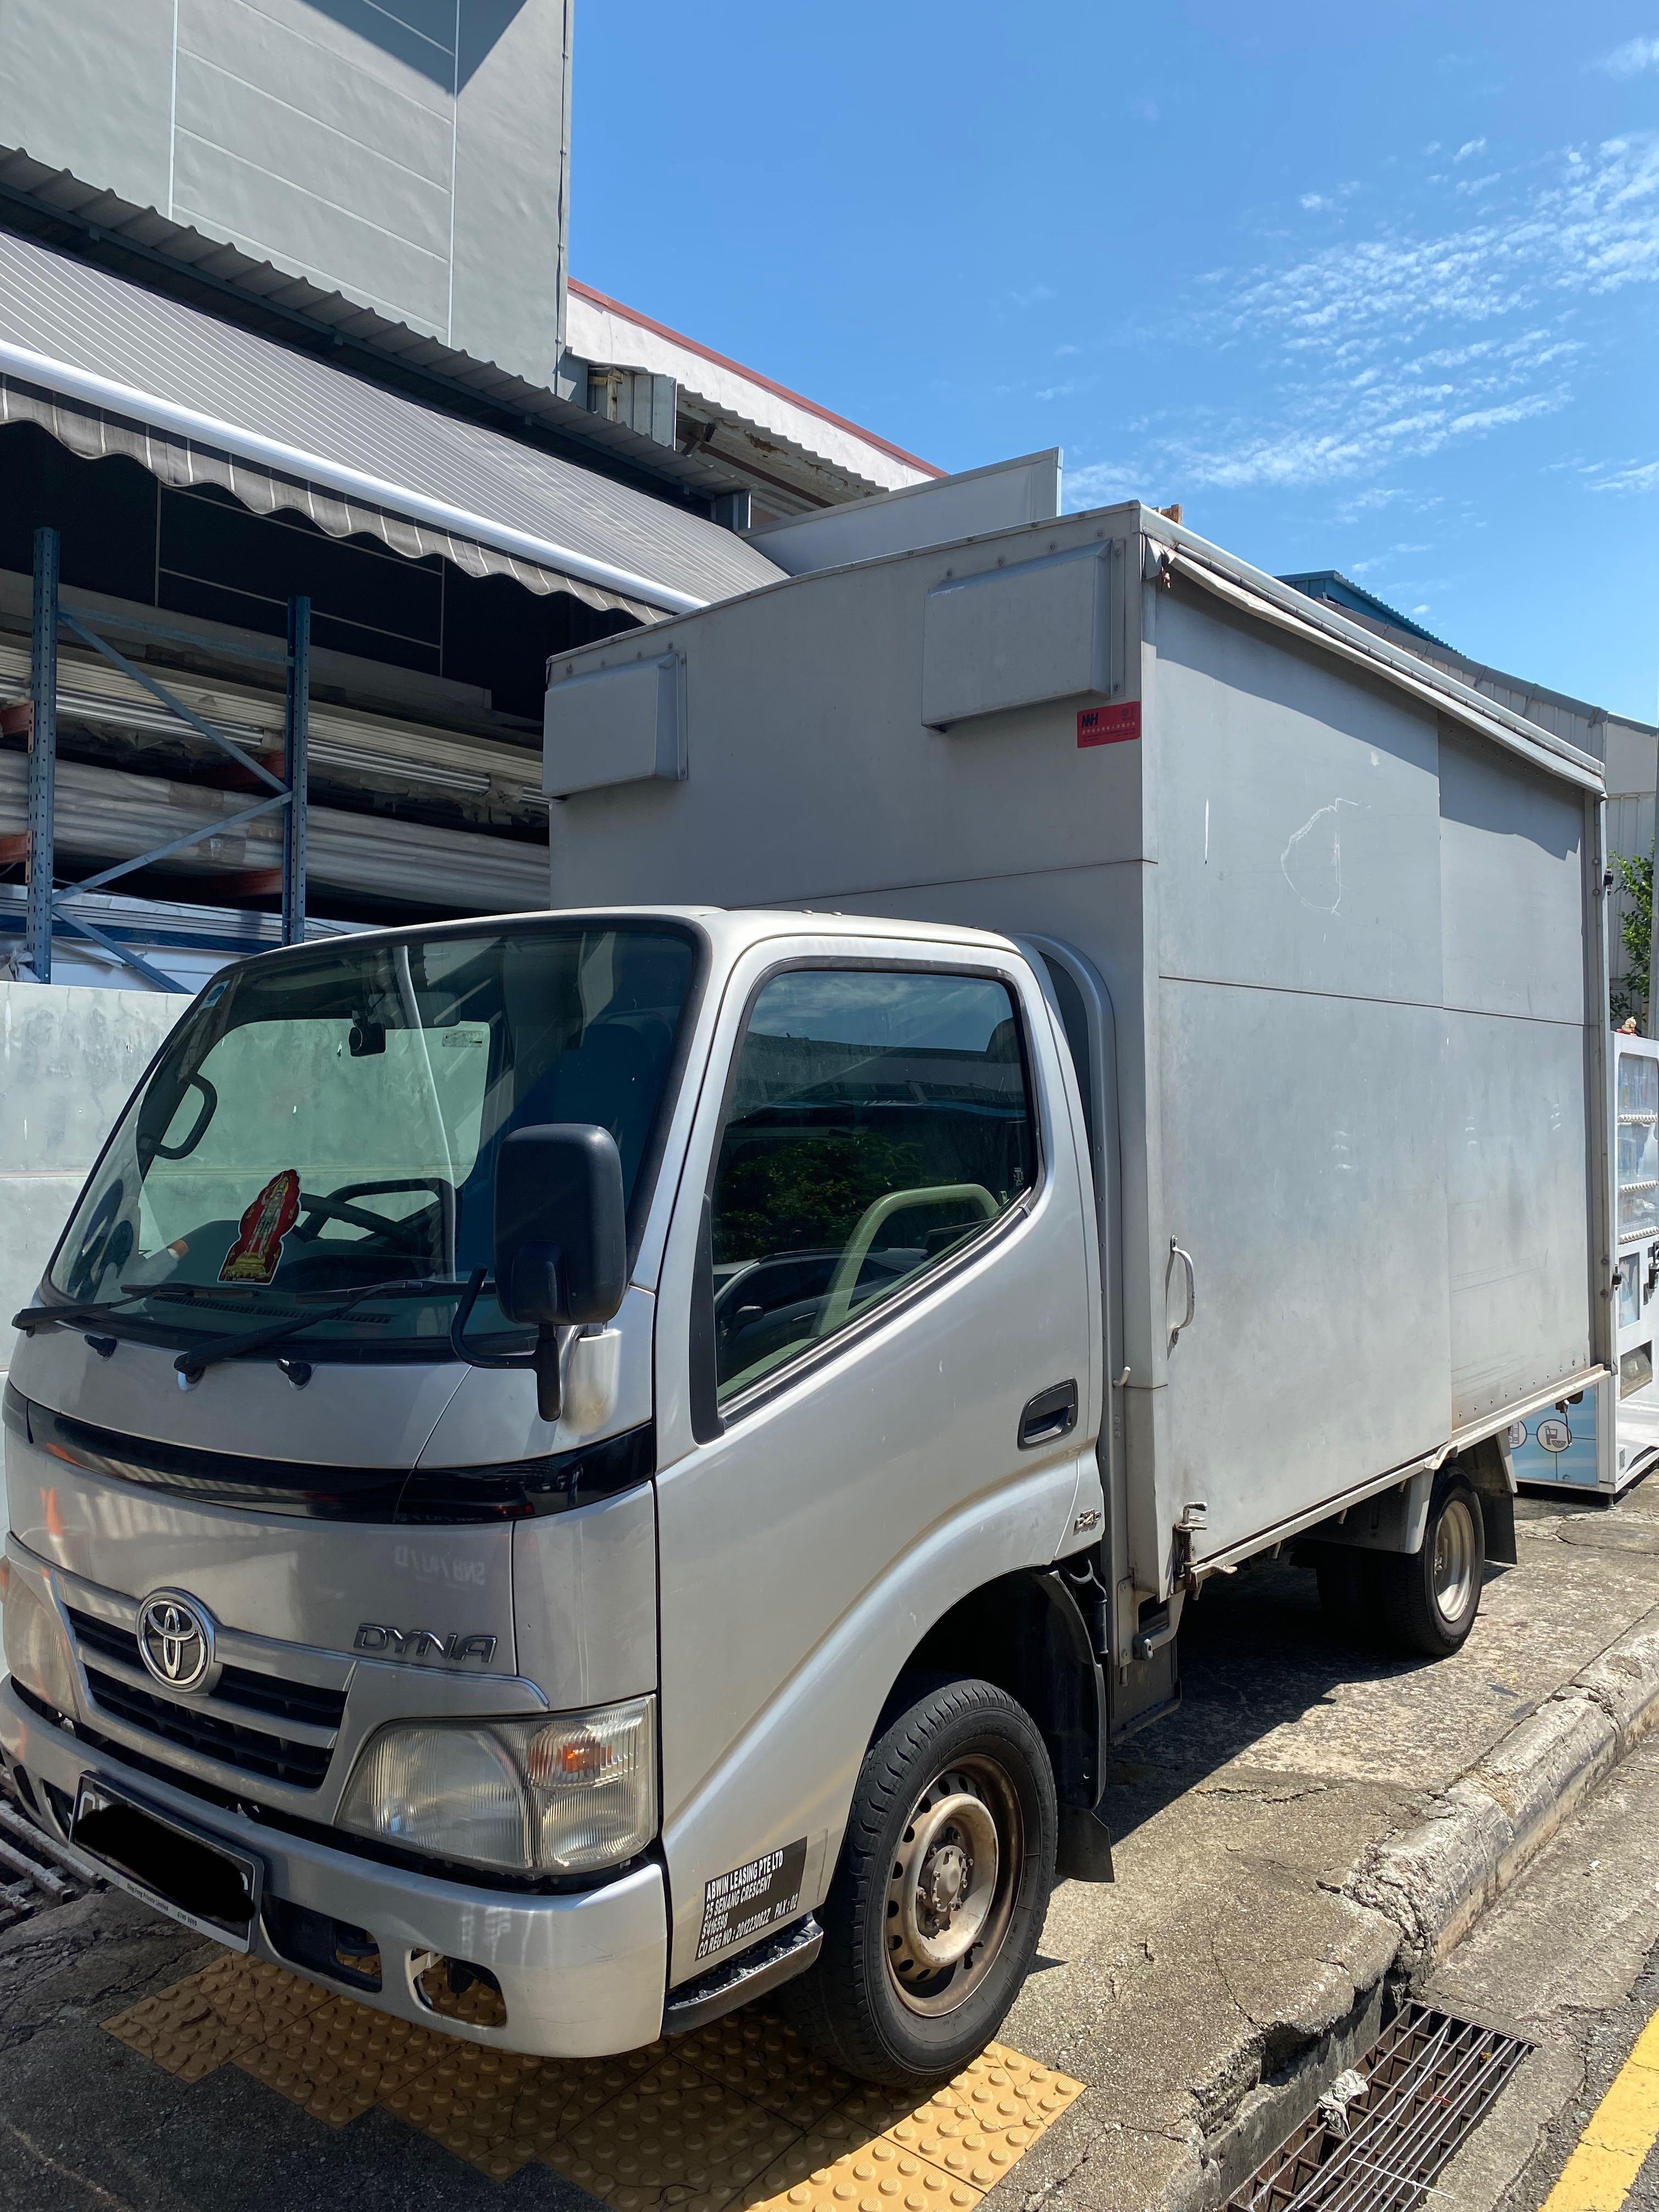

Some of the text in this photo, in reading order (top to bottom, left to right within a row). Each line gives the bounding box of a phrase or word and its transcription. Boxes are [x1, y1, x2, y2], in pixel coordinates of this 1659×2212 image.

[353, 1623, 497, 1663] DYNA
[704, 1873, 772, 1921] 25 SENANG CRESCENT
[706, 1850, 783, 1902] ABWIN LEASING PTE LTD
[698, 1939, 709, 1959] CO
[707, 1932, 723, 1954] REG
